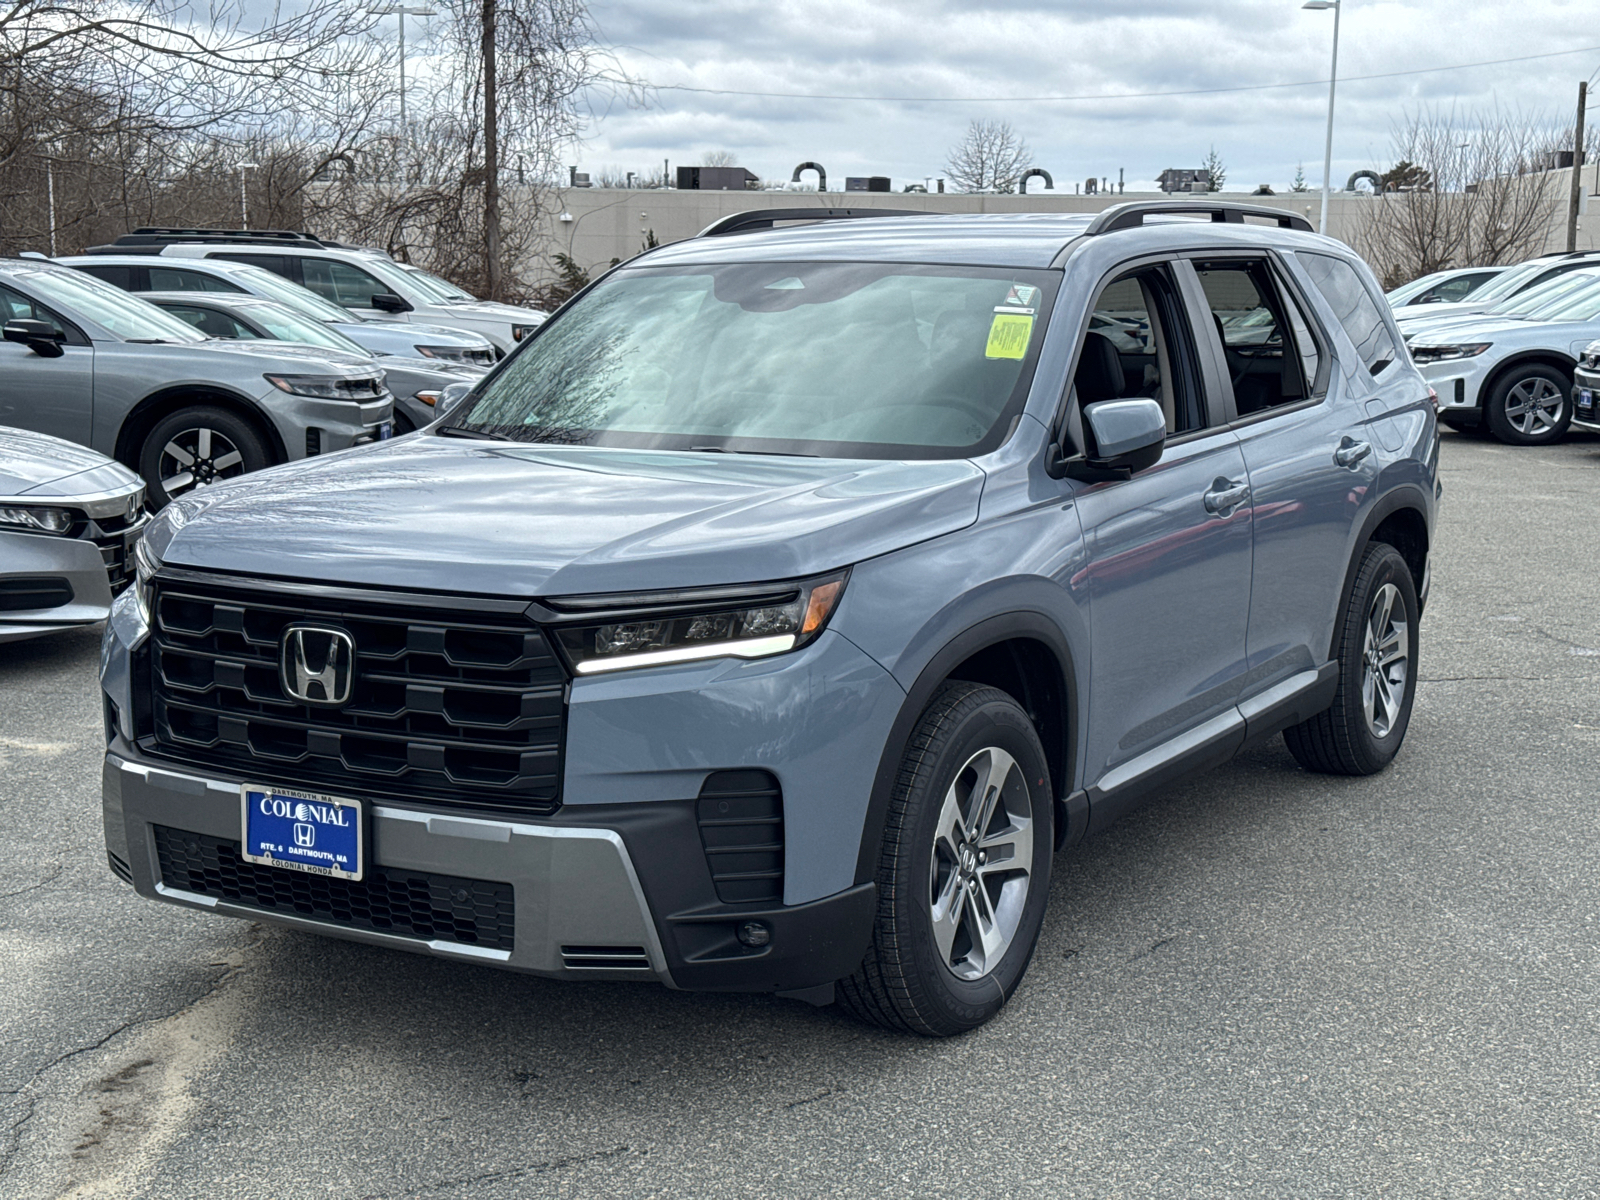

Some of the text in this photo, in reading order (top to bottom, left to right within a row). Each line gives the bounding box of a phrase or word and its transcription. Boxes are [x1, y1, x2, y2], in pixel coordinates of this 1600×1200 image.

[321, 795, 333, 803] MA
[260, 798, 349, 827] COLONIAL
[260, 842, 348, 864] RTE. 6 DARTMOUTH, MA
[271, 859, 333, 876] COLONIAL HONDA
